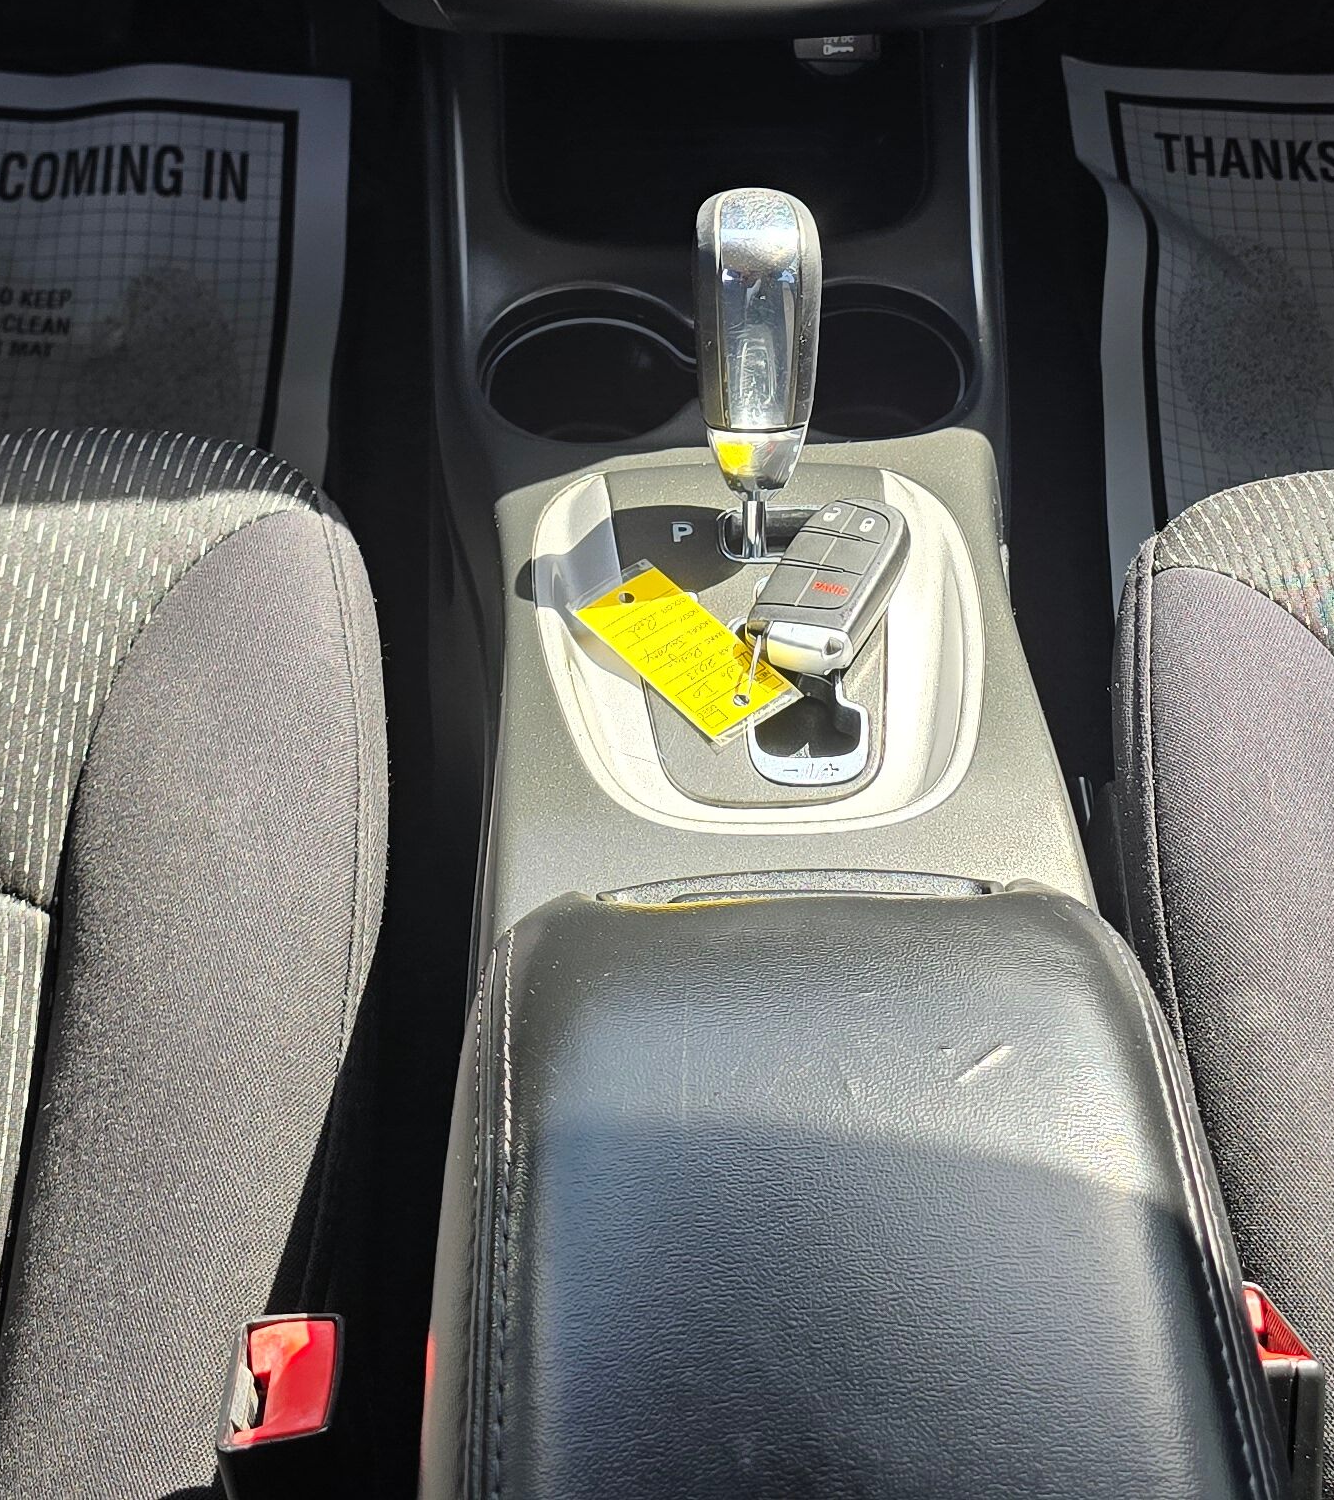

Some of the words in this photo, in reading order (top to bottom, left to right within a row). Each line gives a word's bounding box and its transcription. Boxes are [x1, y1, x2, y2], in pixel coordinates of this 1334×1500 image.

[202, 151, 250, 203] IN
[19, 288, 72, 309] KEEP
[2, 313, 71, 335] CLEAN
[9, 339, 55, 358] MAT
[672, 521, 695, 542] P
[812, 581, 849, 596] PANIC
